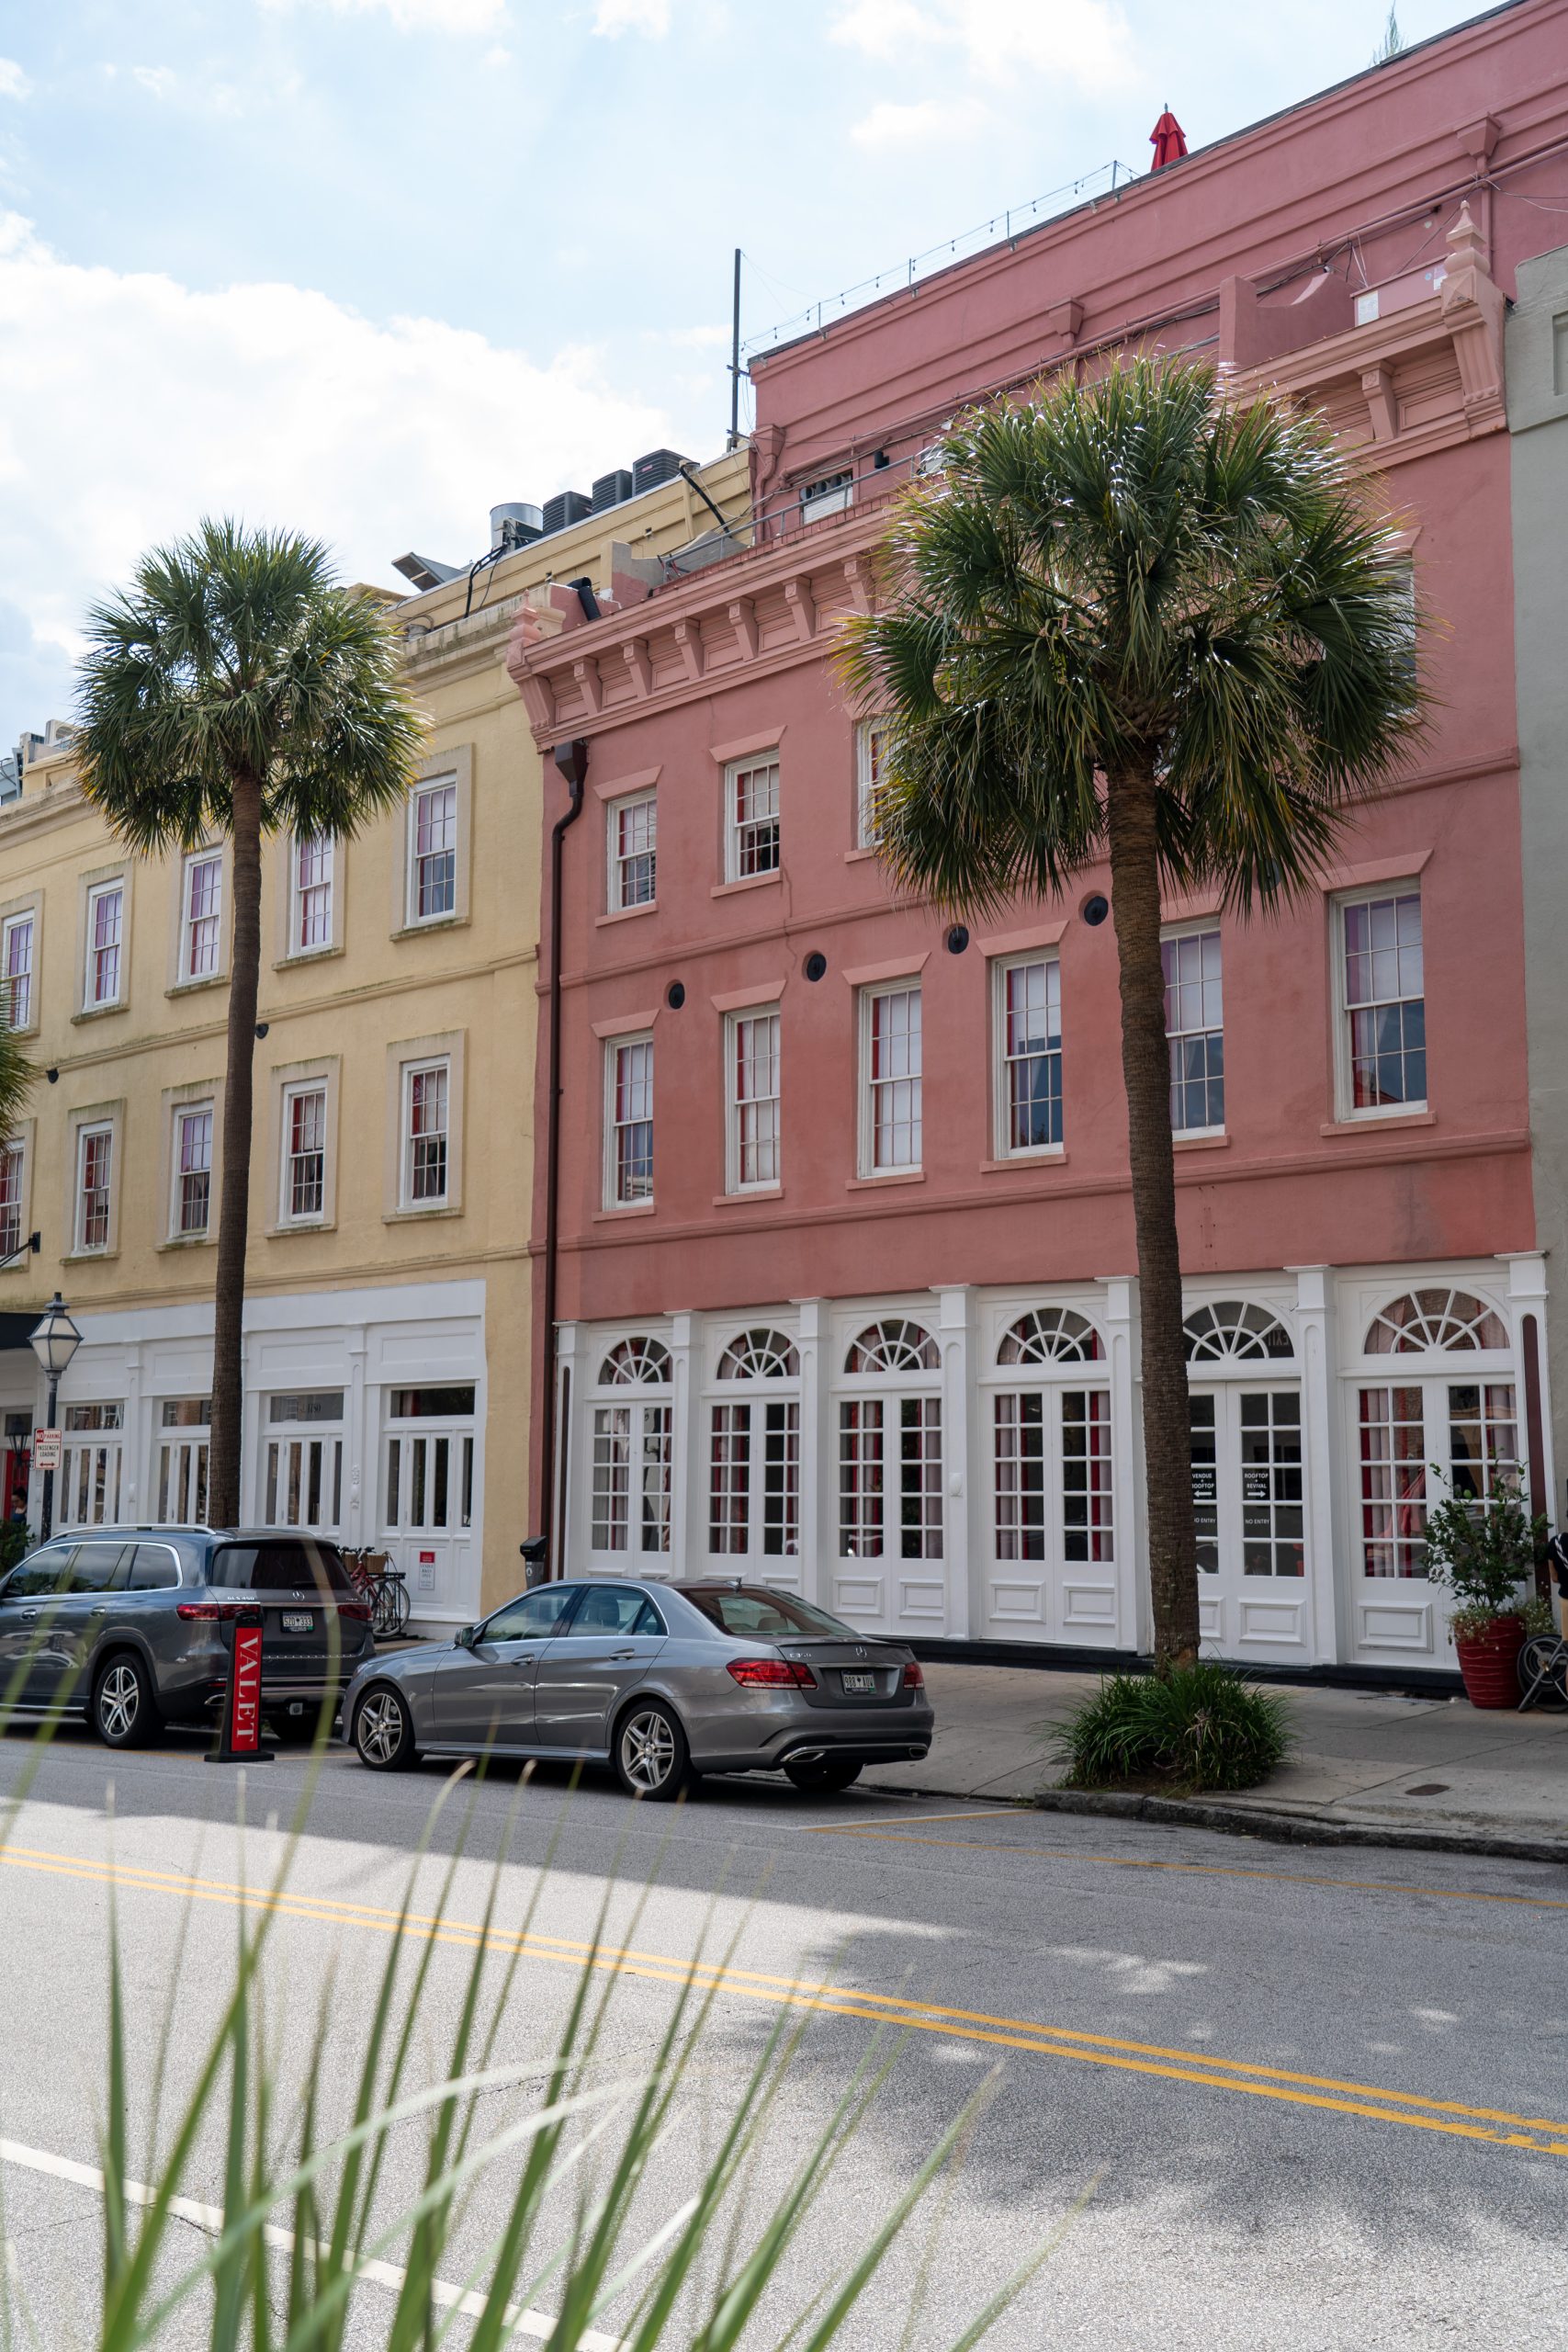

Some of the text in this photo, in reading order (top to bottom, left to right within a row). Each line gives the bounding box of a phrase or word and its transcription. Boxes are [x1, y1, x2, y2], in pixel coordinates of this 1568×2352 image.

[36, 1431, 43, 1441] NO
[300, 1616, 311, 1626] 333
[236, 1634, 259, 1742] VALET
